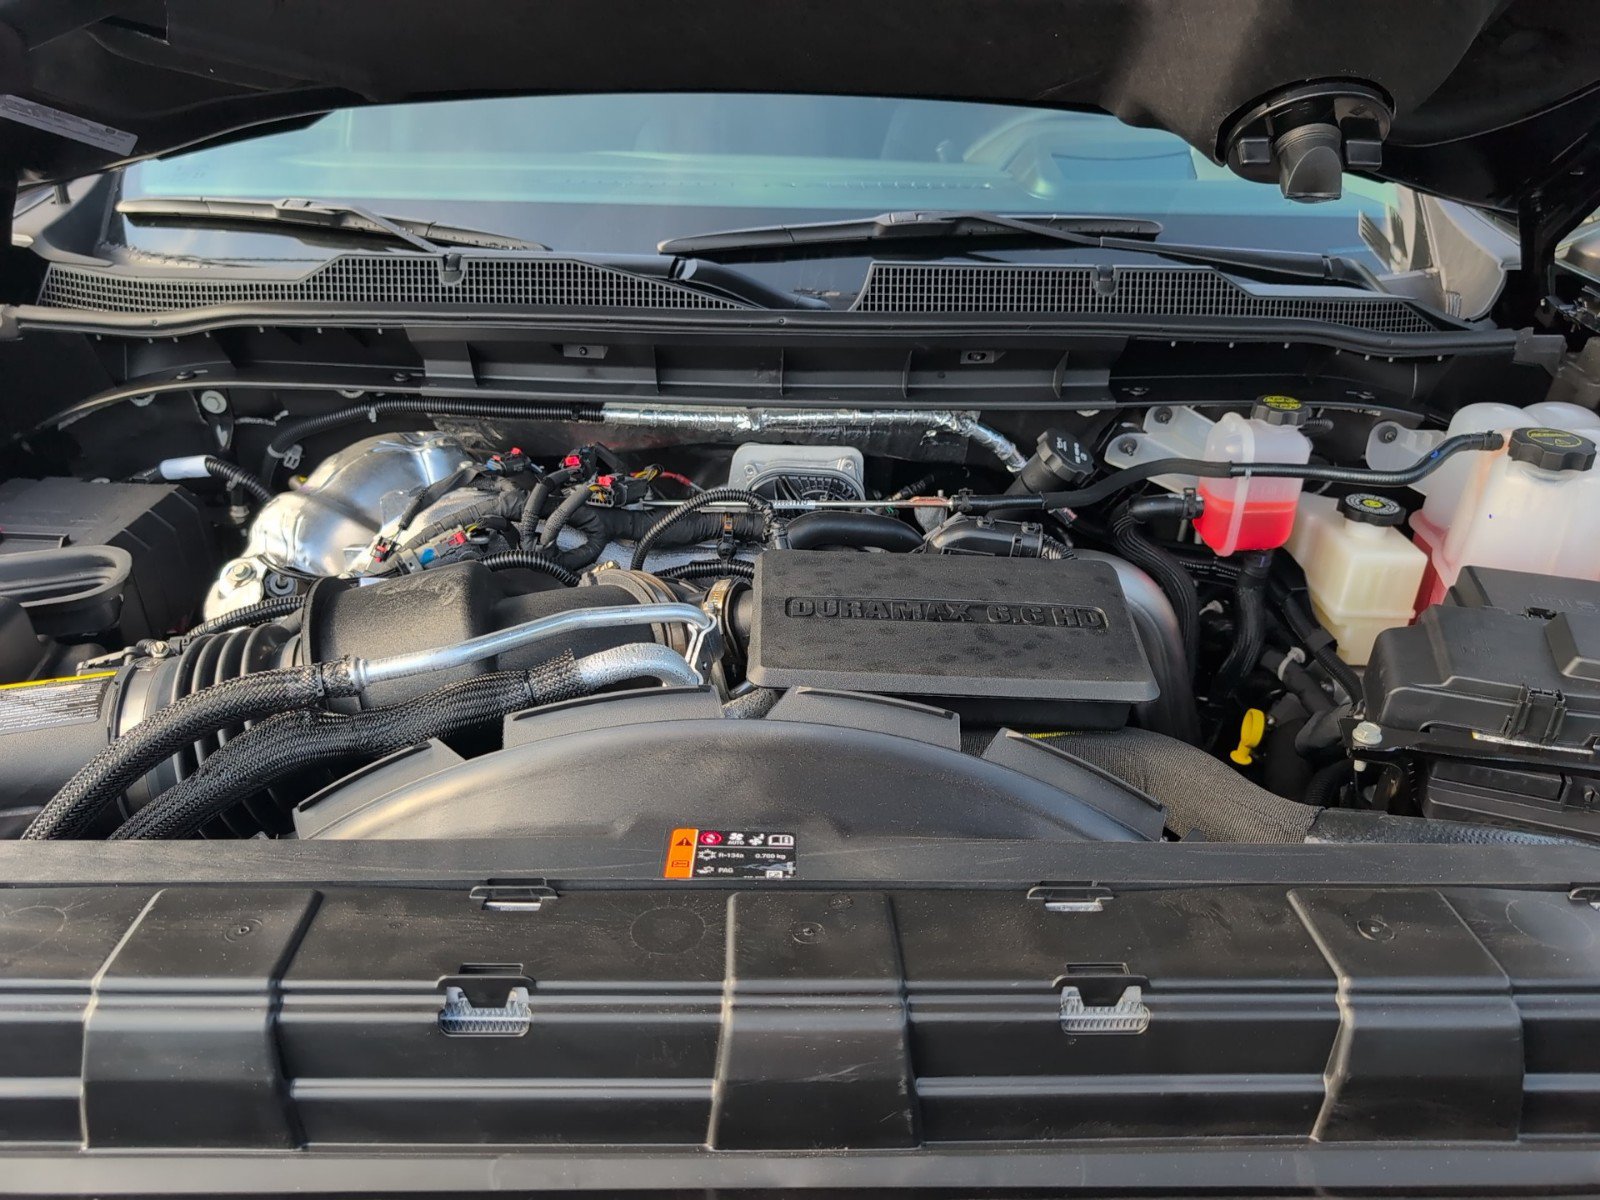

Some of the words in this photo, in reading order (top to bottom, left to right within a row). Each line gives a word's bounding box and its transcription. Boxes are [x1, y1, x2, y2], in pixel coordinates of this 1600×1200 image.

[791, 599, 973, 622] DURAMAX
[986, 604, 1046, 624] 6.6
[1051, 606, 1104, 628] HD
